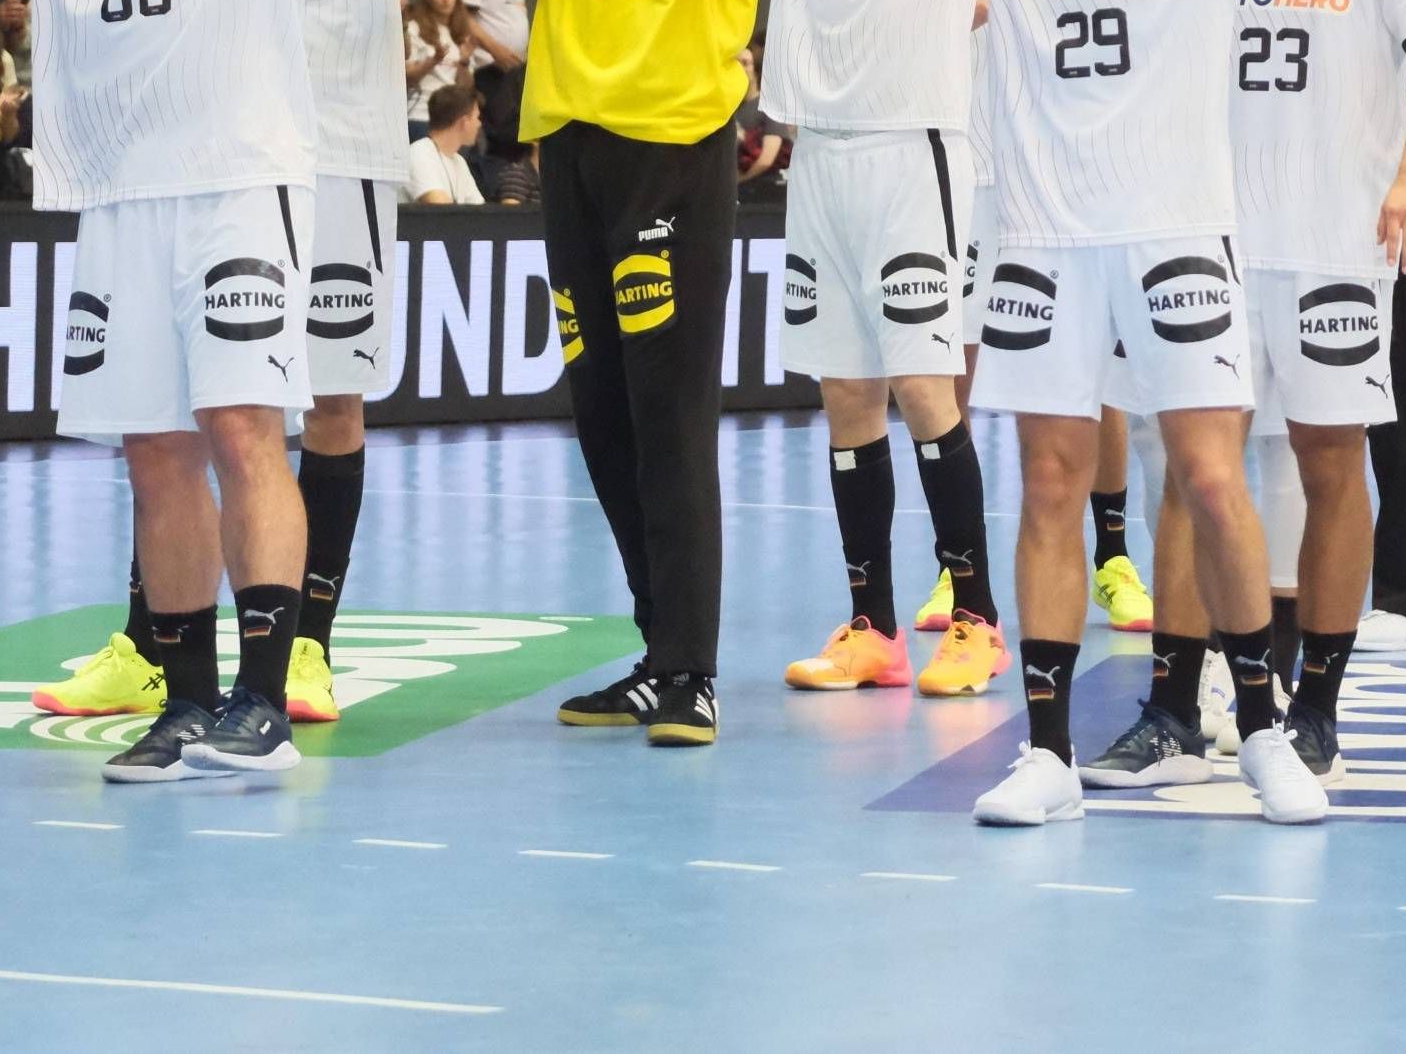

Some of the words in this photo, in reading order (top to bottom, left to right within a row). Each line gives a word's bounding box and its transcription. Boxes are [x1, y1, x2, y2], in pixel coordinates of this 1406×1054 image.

[1056, 7, 1131, 79] 29
[1239, 27, 1309, 92] 23
[638, 227, 669, 241] PUMA
[617, 281, 673, 304] ARTING
[785, 283, 817, 300] RTING
[883, 281, 948, 297] HARTING
[205, 293, 285, 309] HARTING
[310, 293, 373, 308] ARTING
[987, 297, 1053, 321] ARTING
[1149, 290, 1229, 312] HARTING
[1300, 316, 1378, 334] HARTING
